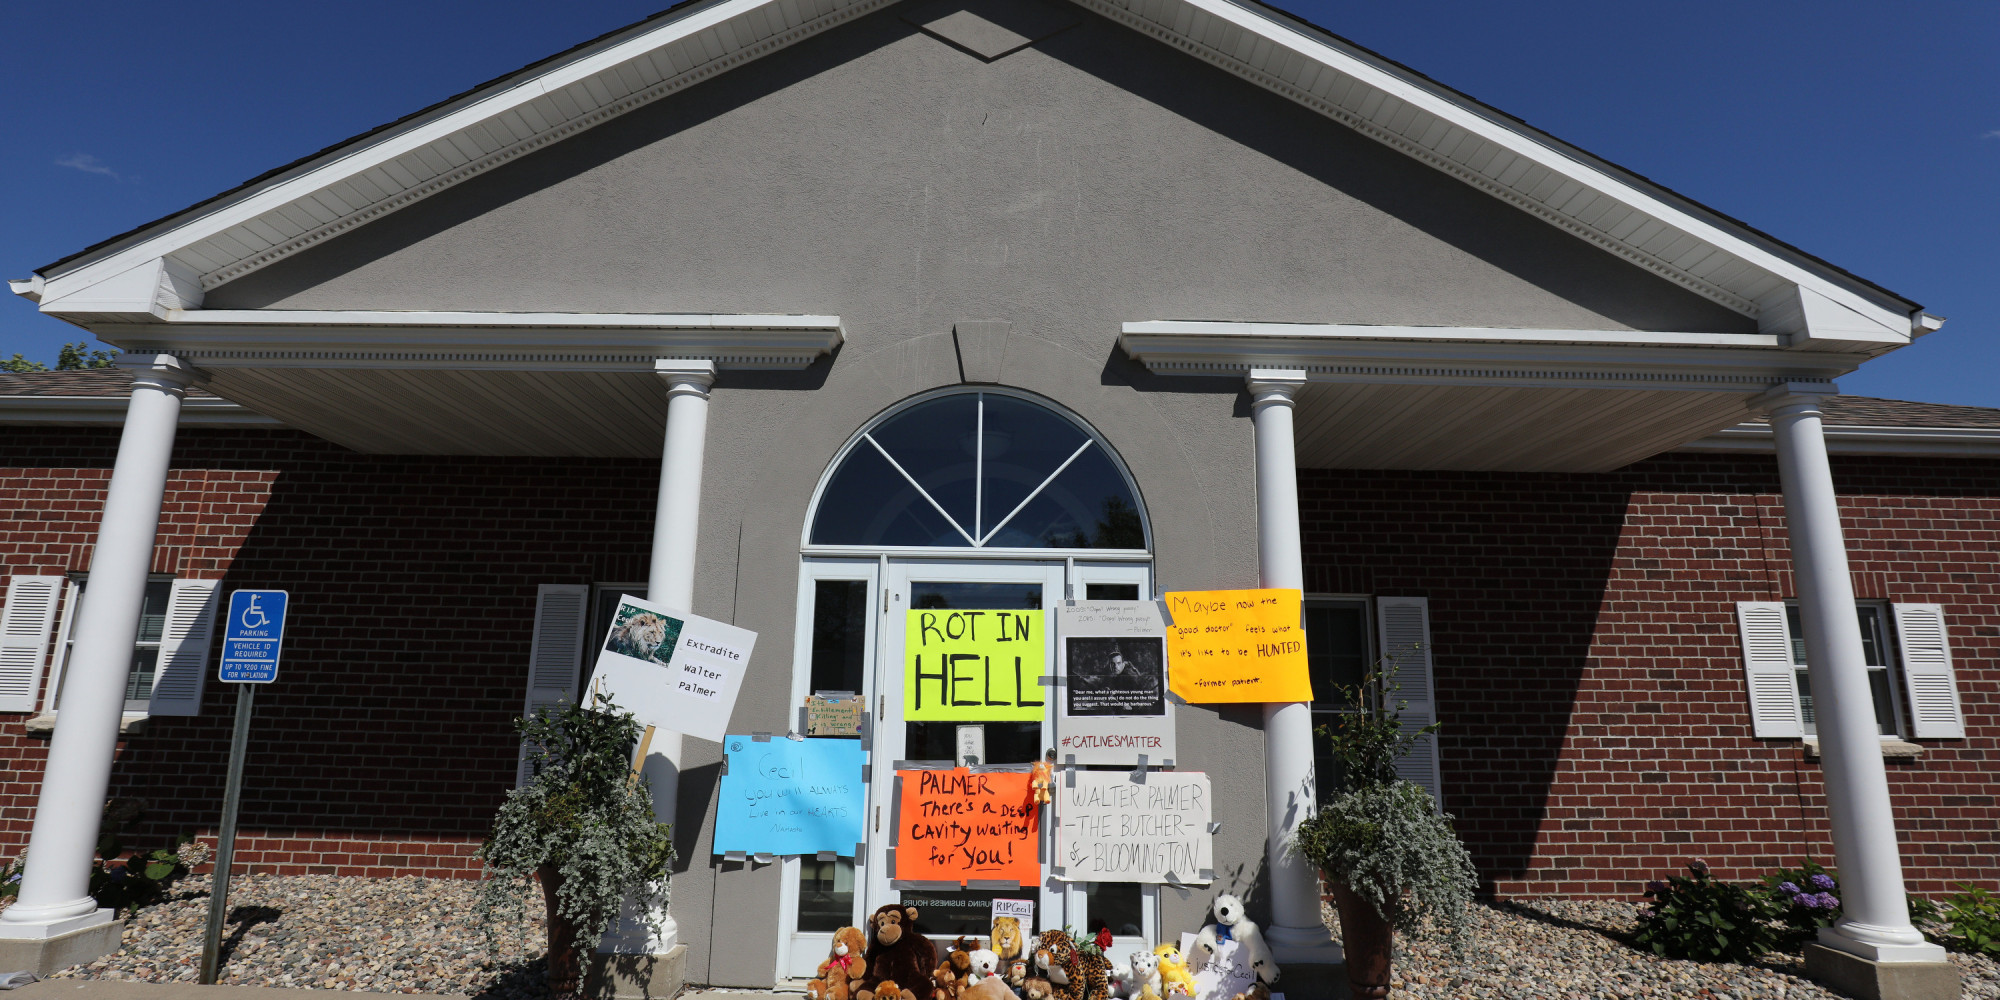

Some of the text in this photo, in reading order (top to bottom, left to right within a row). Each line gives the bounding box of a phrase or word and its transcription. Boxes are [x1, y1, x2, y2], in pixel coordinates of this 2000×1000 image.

[620, 605, 636, 613] RIP
[1173, 596, 1278, 615] Maybe now the
[240, 629, 269, 637] PARKING
[921, 612, 1030, 646] ROT IN
[1246, 625, 1266, 634] feels
[1272, 625, 1291, 634] what
[686, 638, 740, 660] Extradite
[1198, 648, 1214, 656] like
[1221, 648, 1230, 656] to
[1238, 648, 1248, 656] be
[1257, 640, 1301, 658] HUNTED
[684, 664, 722, 680] Walter
[678, 681, 716, 697] Palmer
[915, 653, 1044, 711] HELL
[1062, 734, 1162, 748] #CATLIVESMATTER
[758, 752, 804, 780] Cecil
[810, 784, 849, 795] ALWAYS
[920, 770, 995, 796] PALMER
[1072, 784, 1204, 811] WALTER PALMER
[808, 806, 848, 818] HEARTS
[920, 798, 1034, 818] There's a DEEP
[928, 846, 954, 866] for
[1093, 838, 1199, 875] BLOOMINGTON
[996, 902, 1011, 910] RIP
[1012, 902, 1030, 914] Cecil
[1234, 964, 1254, 980] Cecil
